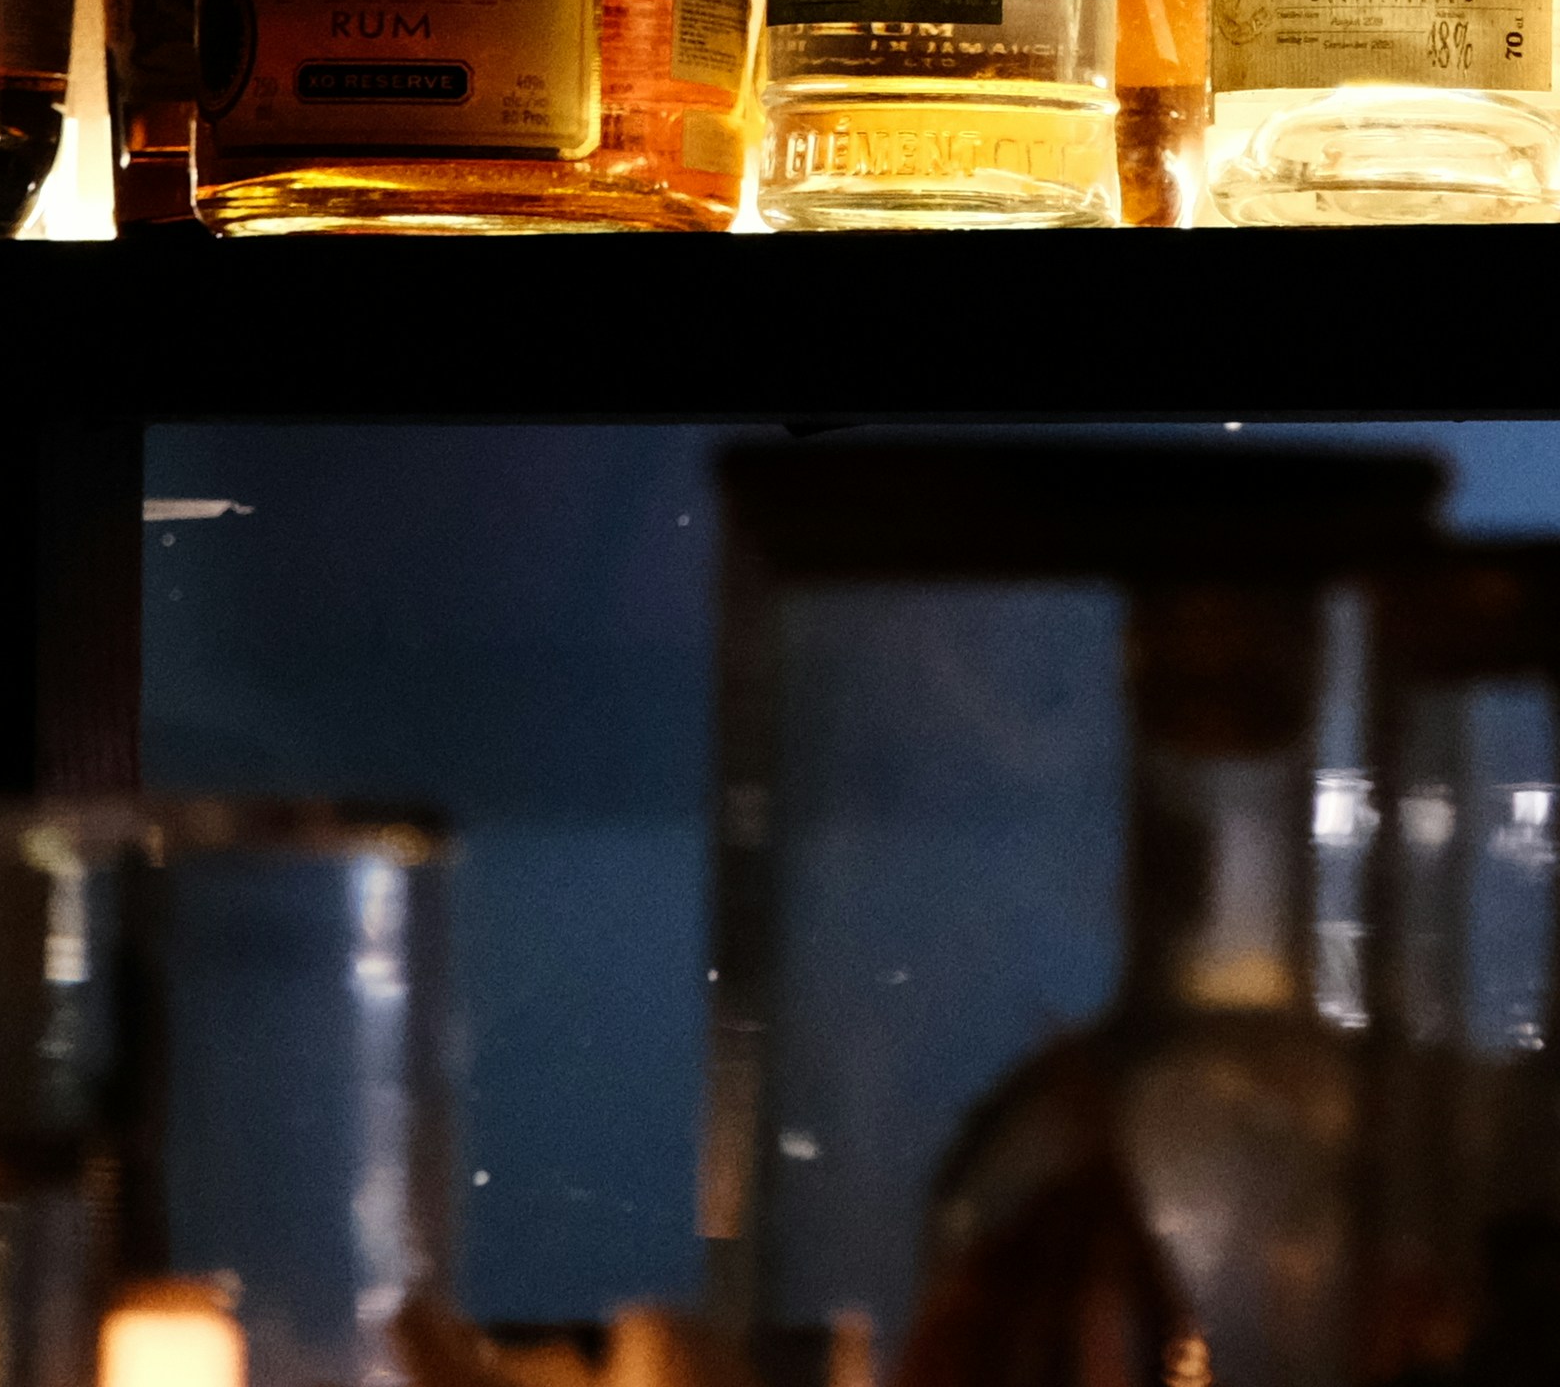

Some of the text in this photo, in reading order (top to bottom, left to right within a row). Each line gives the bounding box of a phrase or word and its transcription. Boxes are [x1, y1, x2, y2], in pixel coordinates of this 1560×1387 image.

[331, 11, 431, 39] RUM
[1505, 32, 1524, 60] 70
[308, 74, 456, 90] XO RESERVE
